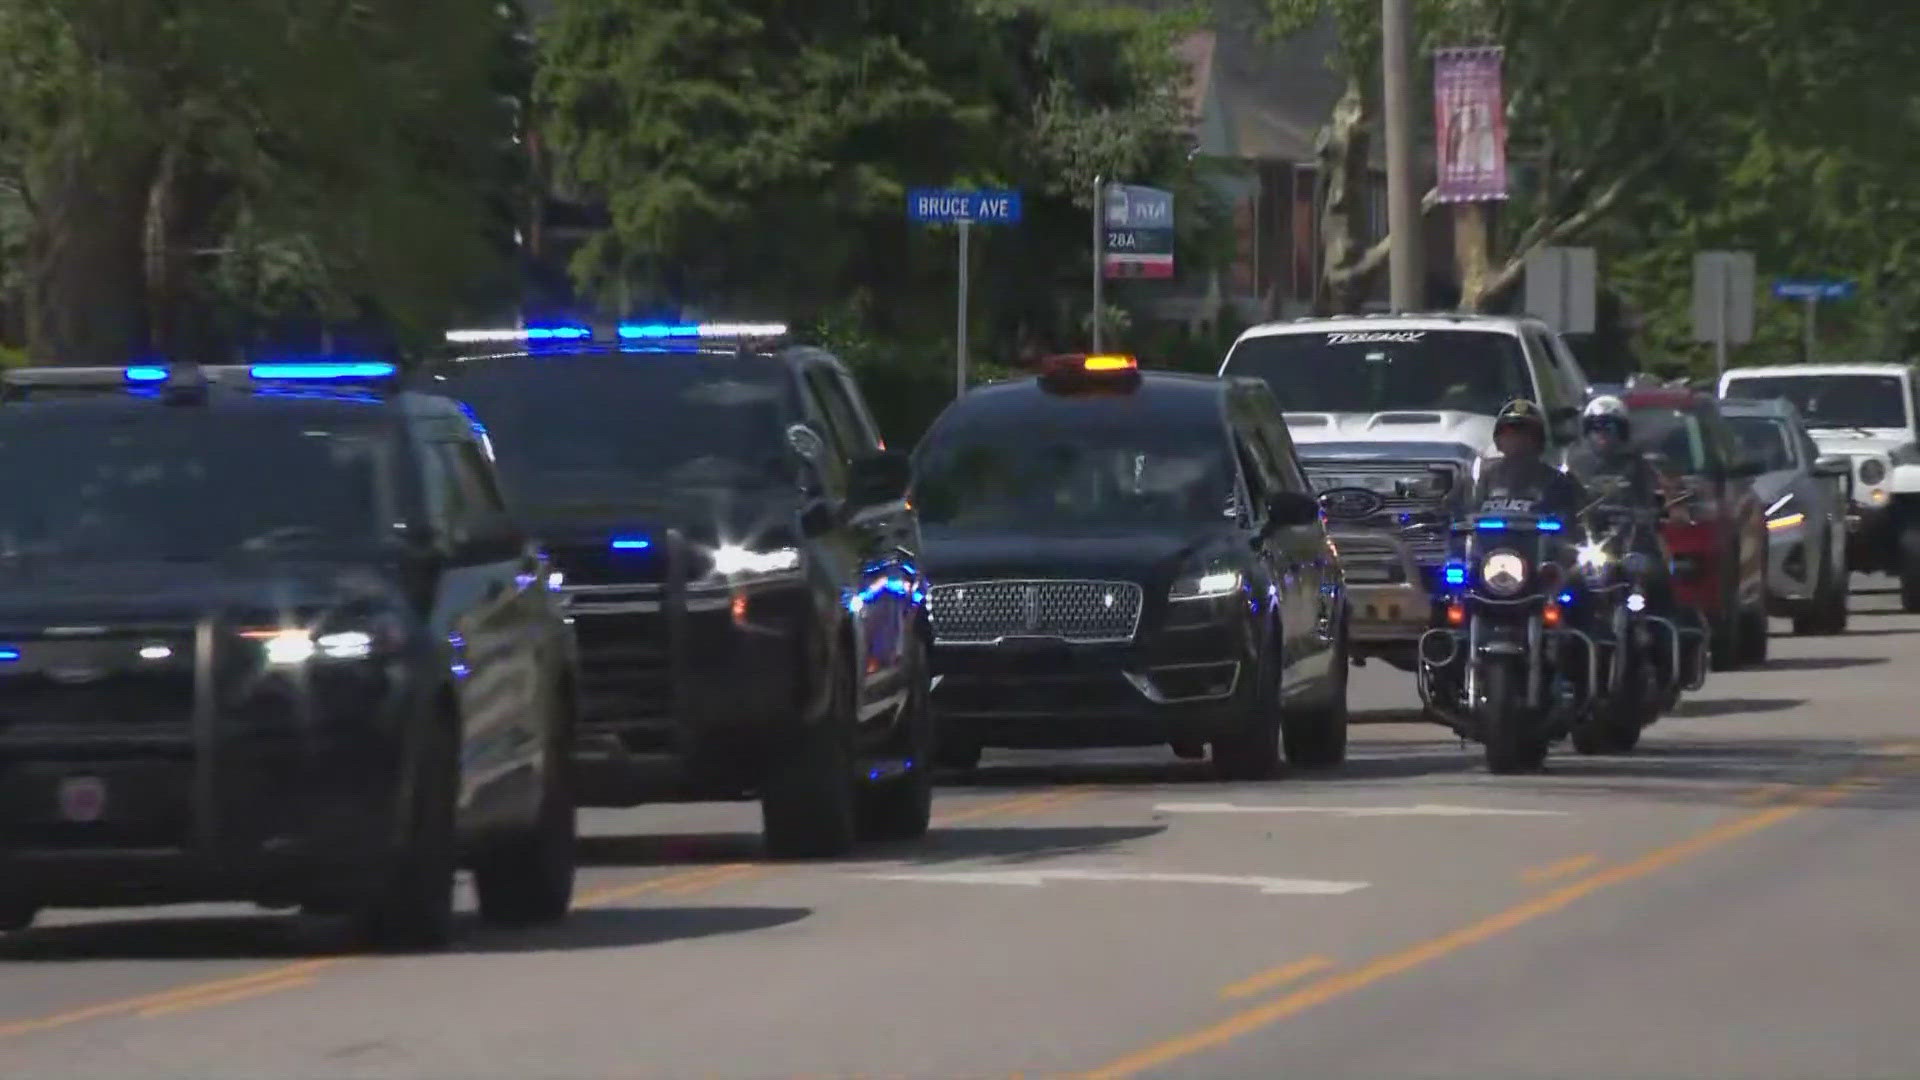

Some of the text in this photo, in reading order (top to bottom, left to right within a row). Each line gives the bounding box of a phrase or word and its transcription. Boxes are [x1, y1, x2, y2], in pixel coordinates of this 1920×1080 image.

[918, 196, 1009, 218] BRUCE AVE
[1108, 232, 1136, 249] 28A
[1481, 499, 1533, 513] POLICE
